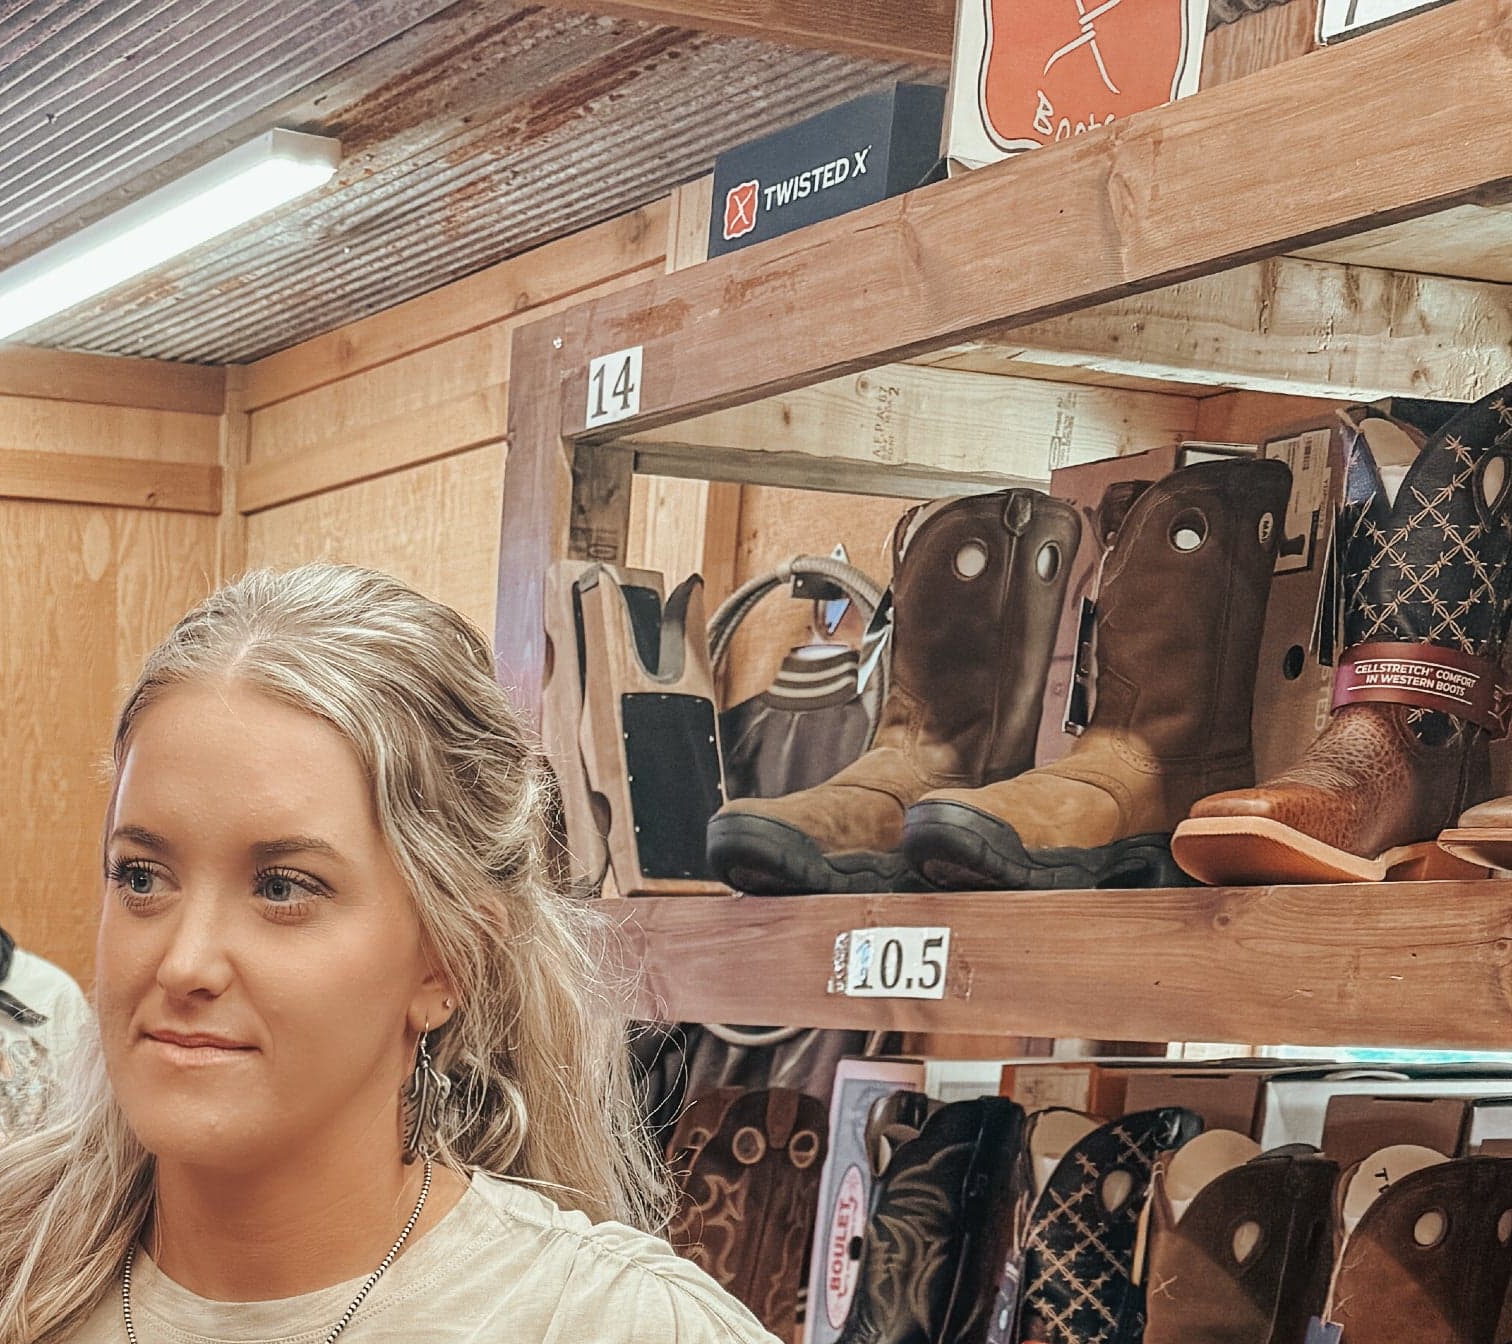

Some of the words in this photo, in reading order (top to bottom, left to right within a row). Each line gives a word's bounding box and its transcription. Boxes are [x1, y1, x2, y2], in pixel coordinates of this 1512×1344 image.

[763, 157, 850, 211] TWISTED
[851, 148, 869, 178] X
[591, 355, 636, 419] 14
[1365, 674, 1379, 684] IN
[1380, 674, 1436, 689] WESTERN
[1435, 680, 1467, 697] BOOTS
[1435, 669, 1477, 689] COMFORT
[853, 936, 945, 990] 10.5
